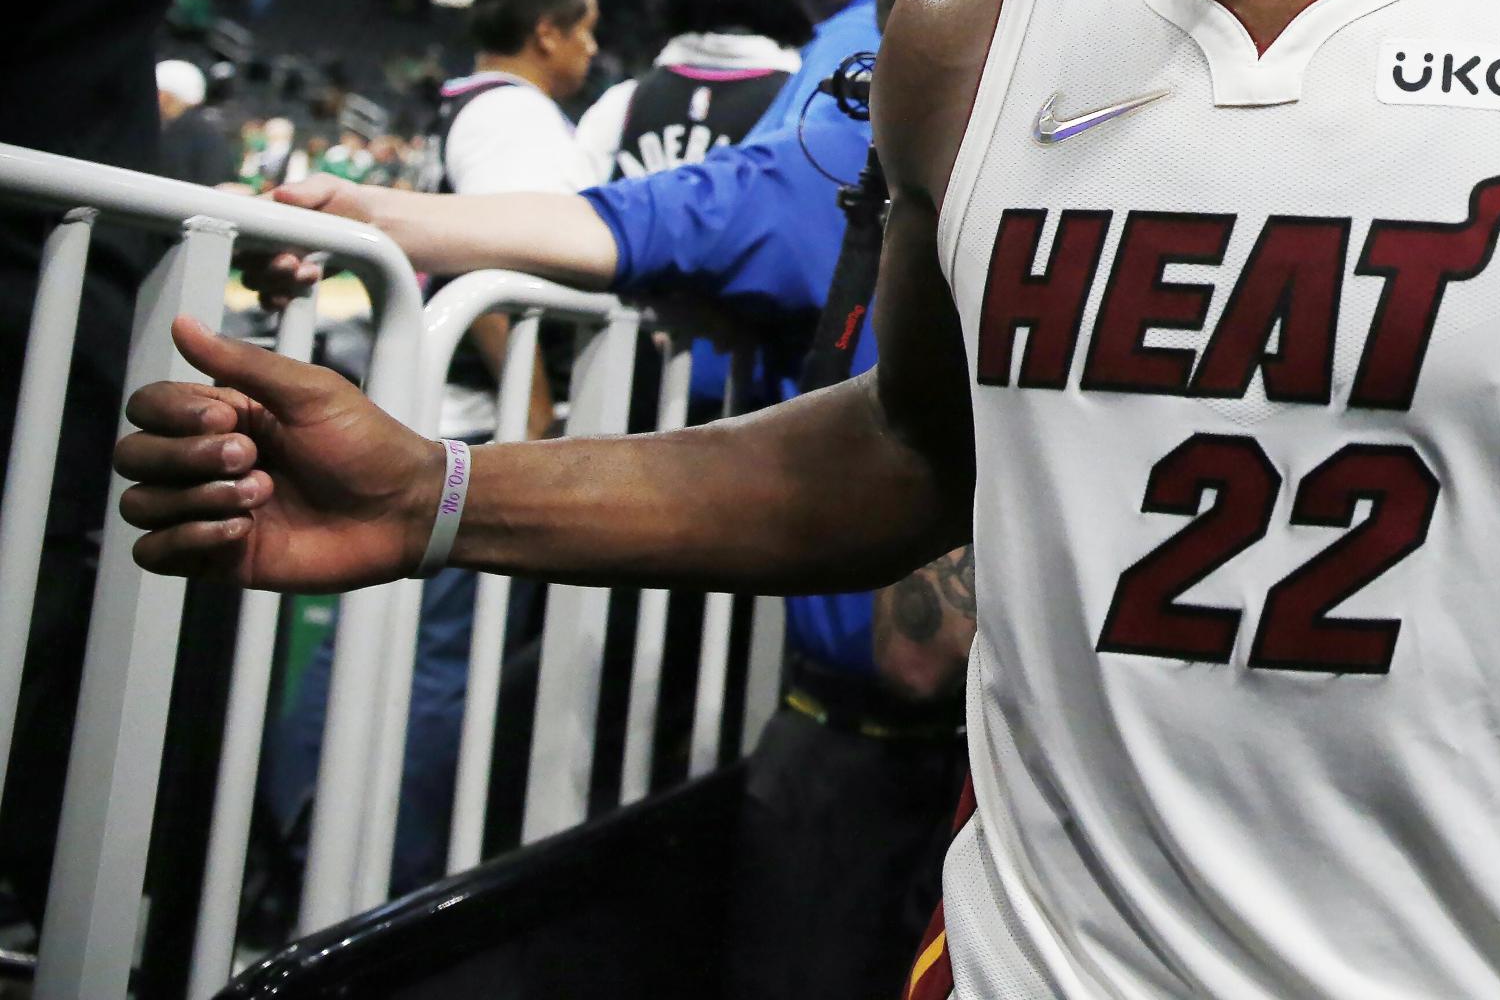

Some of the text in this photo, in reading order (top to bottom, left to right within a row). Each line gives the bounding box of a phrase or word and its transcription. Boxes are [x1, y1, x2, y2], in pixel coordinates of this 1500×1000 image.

[448, 457, 465, 488] One
[441, 492, 460, 515] No
[1096, 432, 1441, 675] 22
